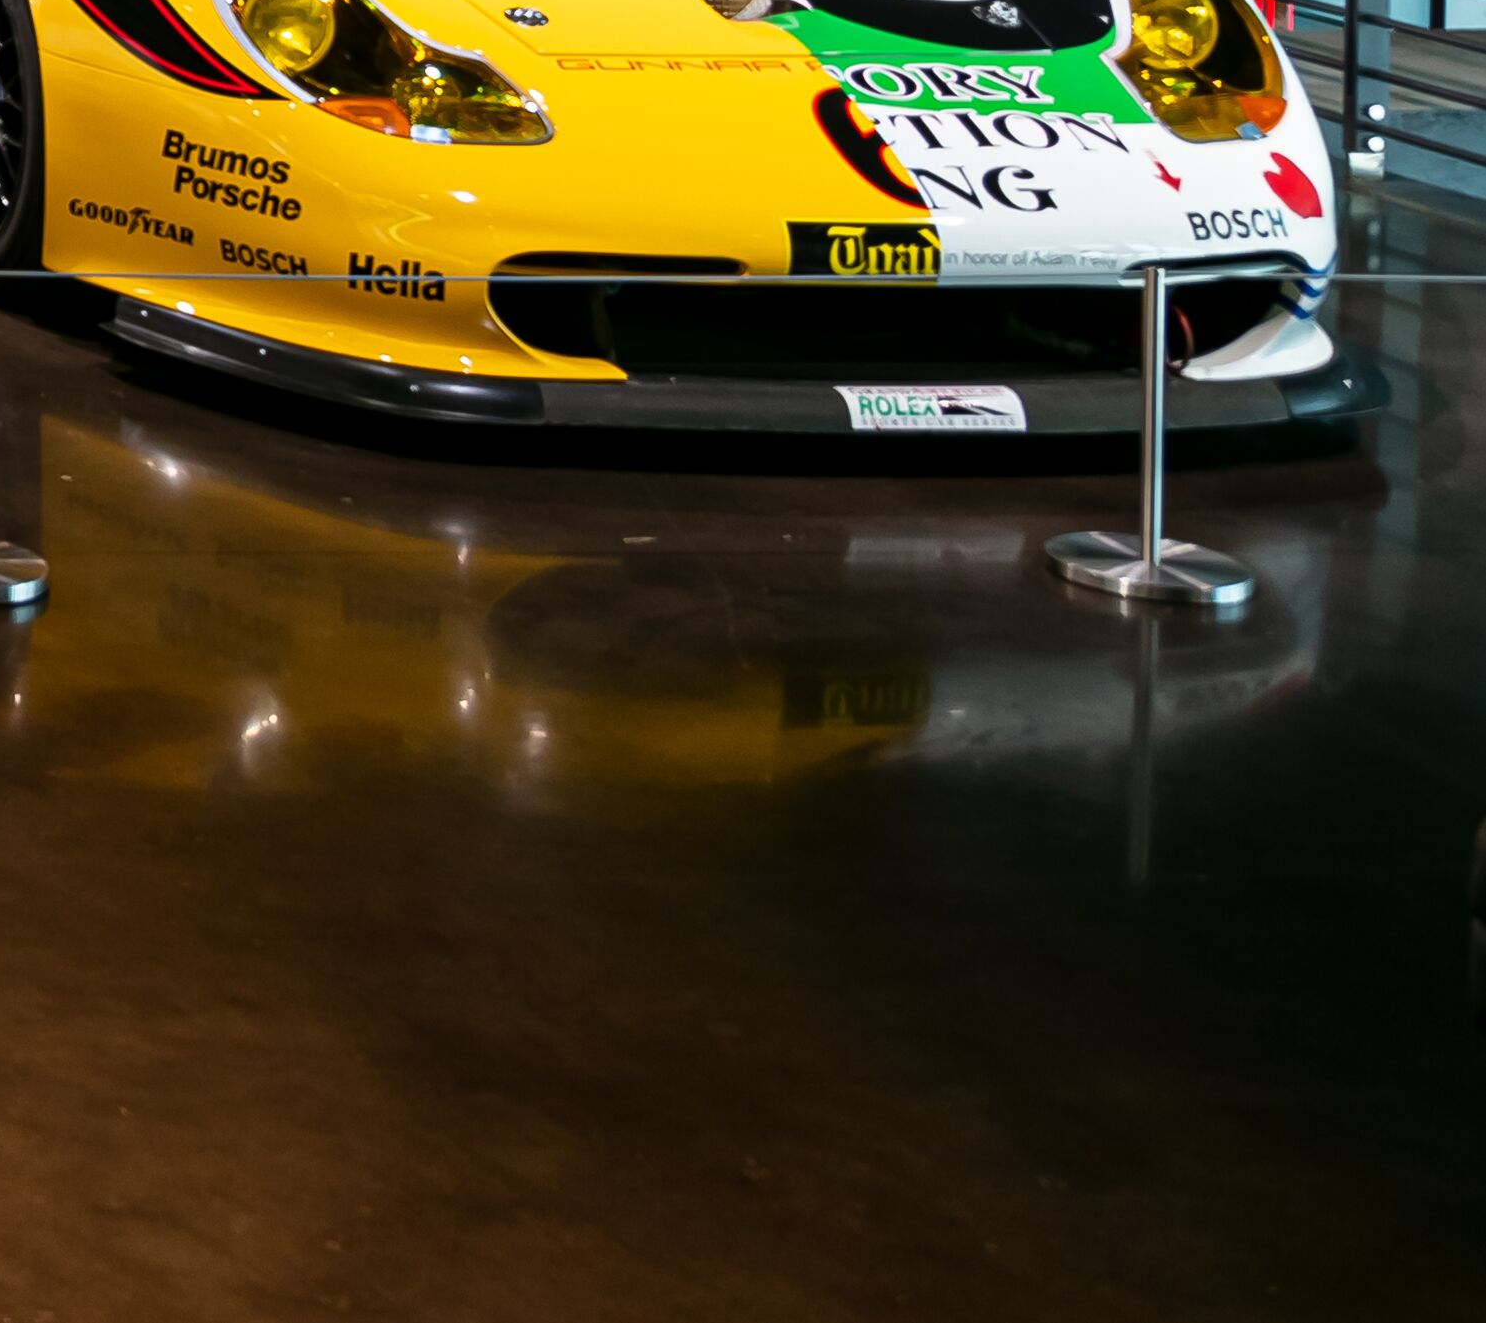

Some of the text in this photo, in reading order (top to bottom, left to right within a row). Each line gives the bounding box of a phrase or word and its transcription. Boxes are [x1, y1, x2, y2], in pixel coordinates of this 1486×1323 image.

[556, 59, 792, 72] GUNNAR
[824, 63, 1055, 105] ORY
[871, 110, 1129, 155] TION
[161, 129, 291, 184] Brumos
[174, 165, 303, 222] Porsche
[69, 198, 194, 247] GOODYEAR
[1186, 209, 1288, 242] BOSCH
[219, 238, 310, 277] BOSCH
[348, 252, 445, 302] Hella
[943, 251, 959, 266] in
[963, 250, 1007, 266] honor
[1011, 250, 1028, 266] of
[1029, 250, 1076, 266] Adam
[857, 395, 936, 416] ROLEX
